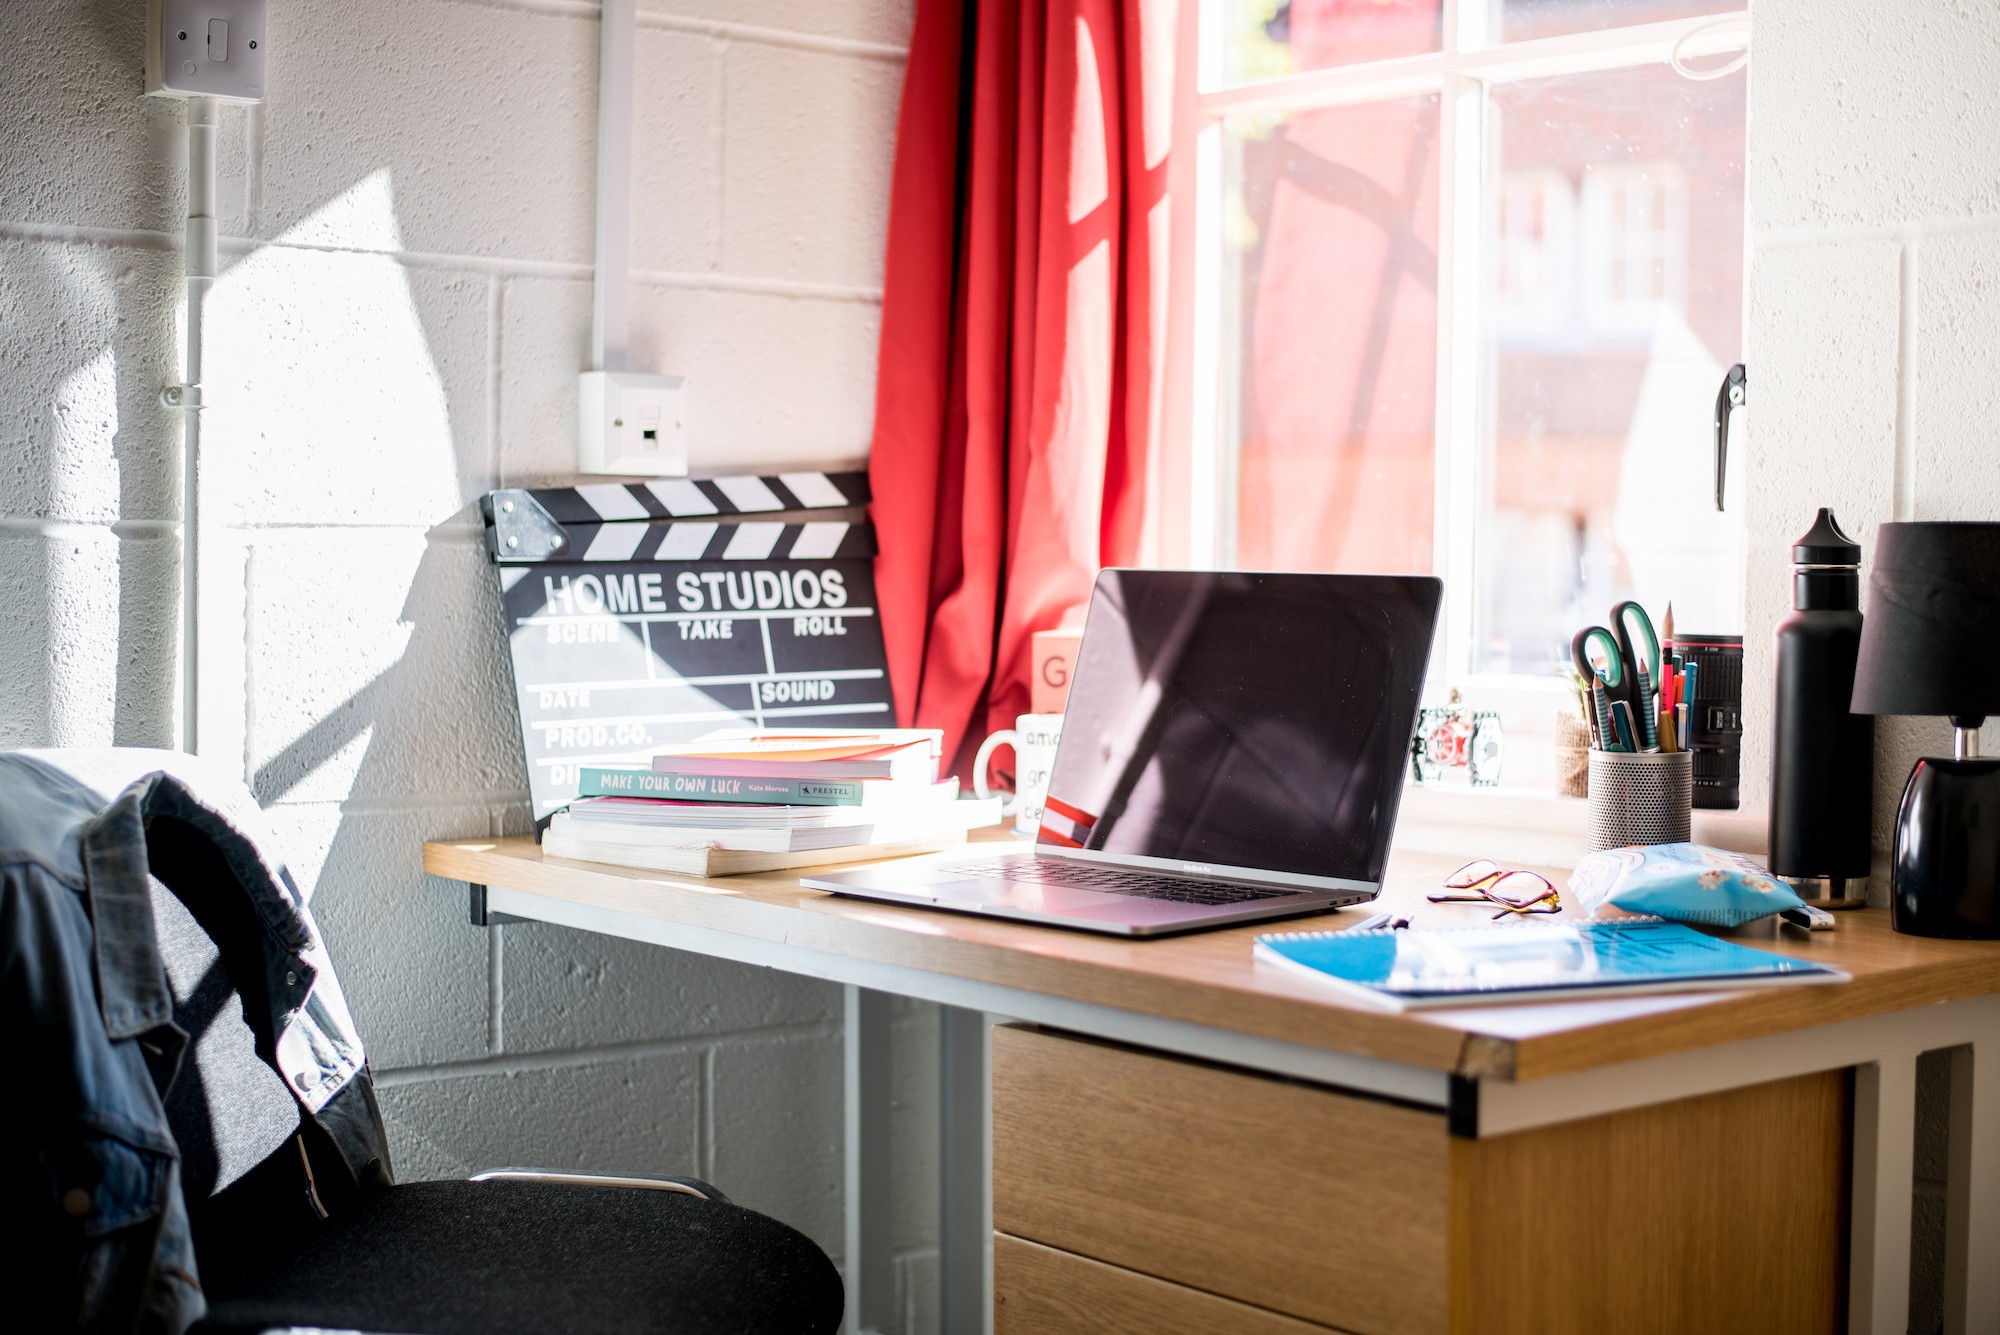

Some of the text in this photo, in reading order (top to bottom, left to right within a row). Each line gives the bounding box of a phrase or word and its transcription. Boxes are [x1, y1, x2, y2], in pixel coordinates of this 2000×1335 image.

[544, 569, 847, 614] HOME STUDIOS
[546, 621, 620, 644] SCENE
[677, 619, 733, 640] TAKE
[793, 616, 847, 637] ROLL
[540, 689, 591, 710] DATE
[761, 680, 835, 703] SOUND
[545, 724, 653, 749] PROD.CO.
[601, 774, 633, 790] MAKE
[639, 775, 670, 791] YOUR
[675, 777, 706, 792] OWN
[711, 778, 740, 794] LUCK
[748, 784, 763, 792] Kate
[813, 787, 849, 795] PRESTEL
